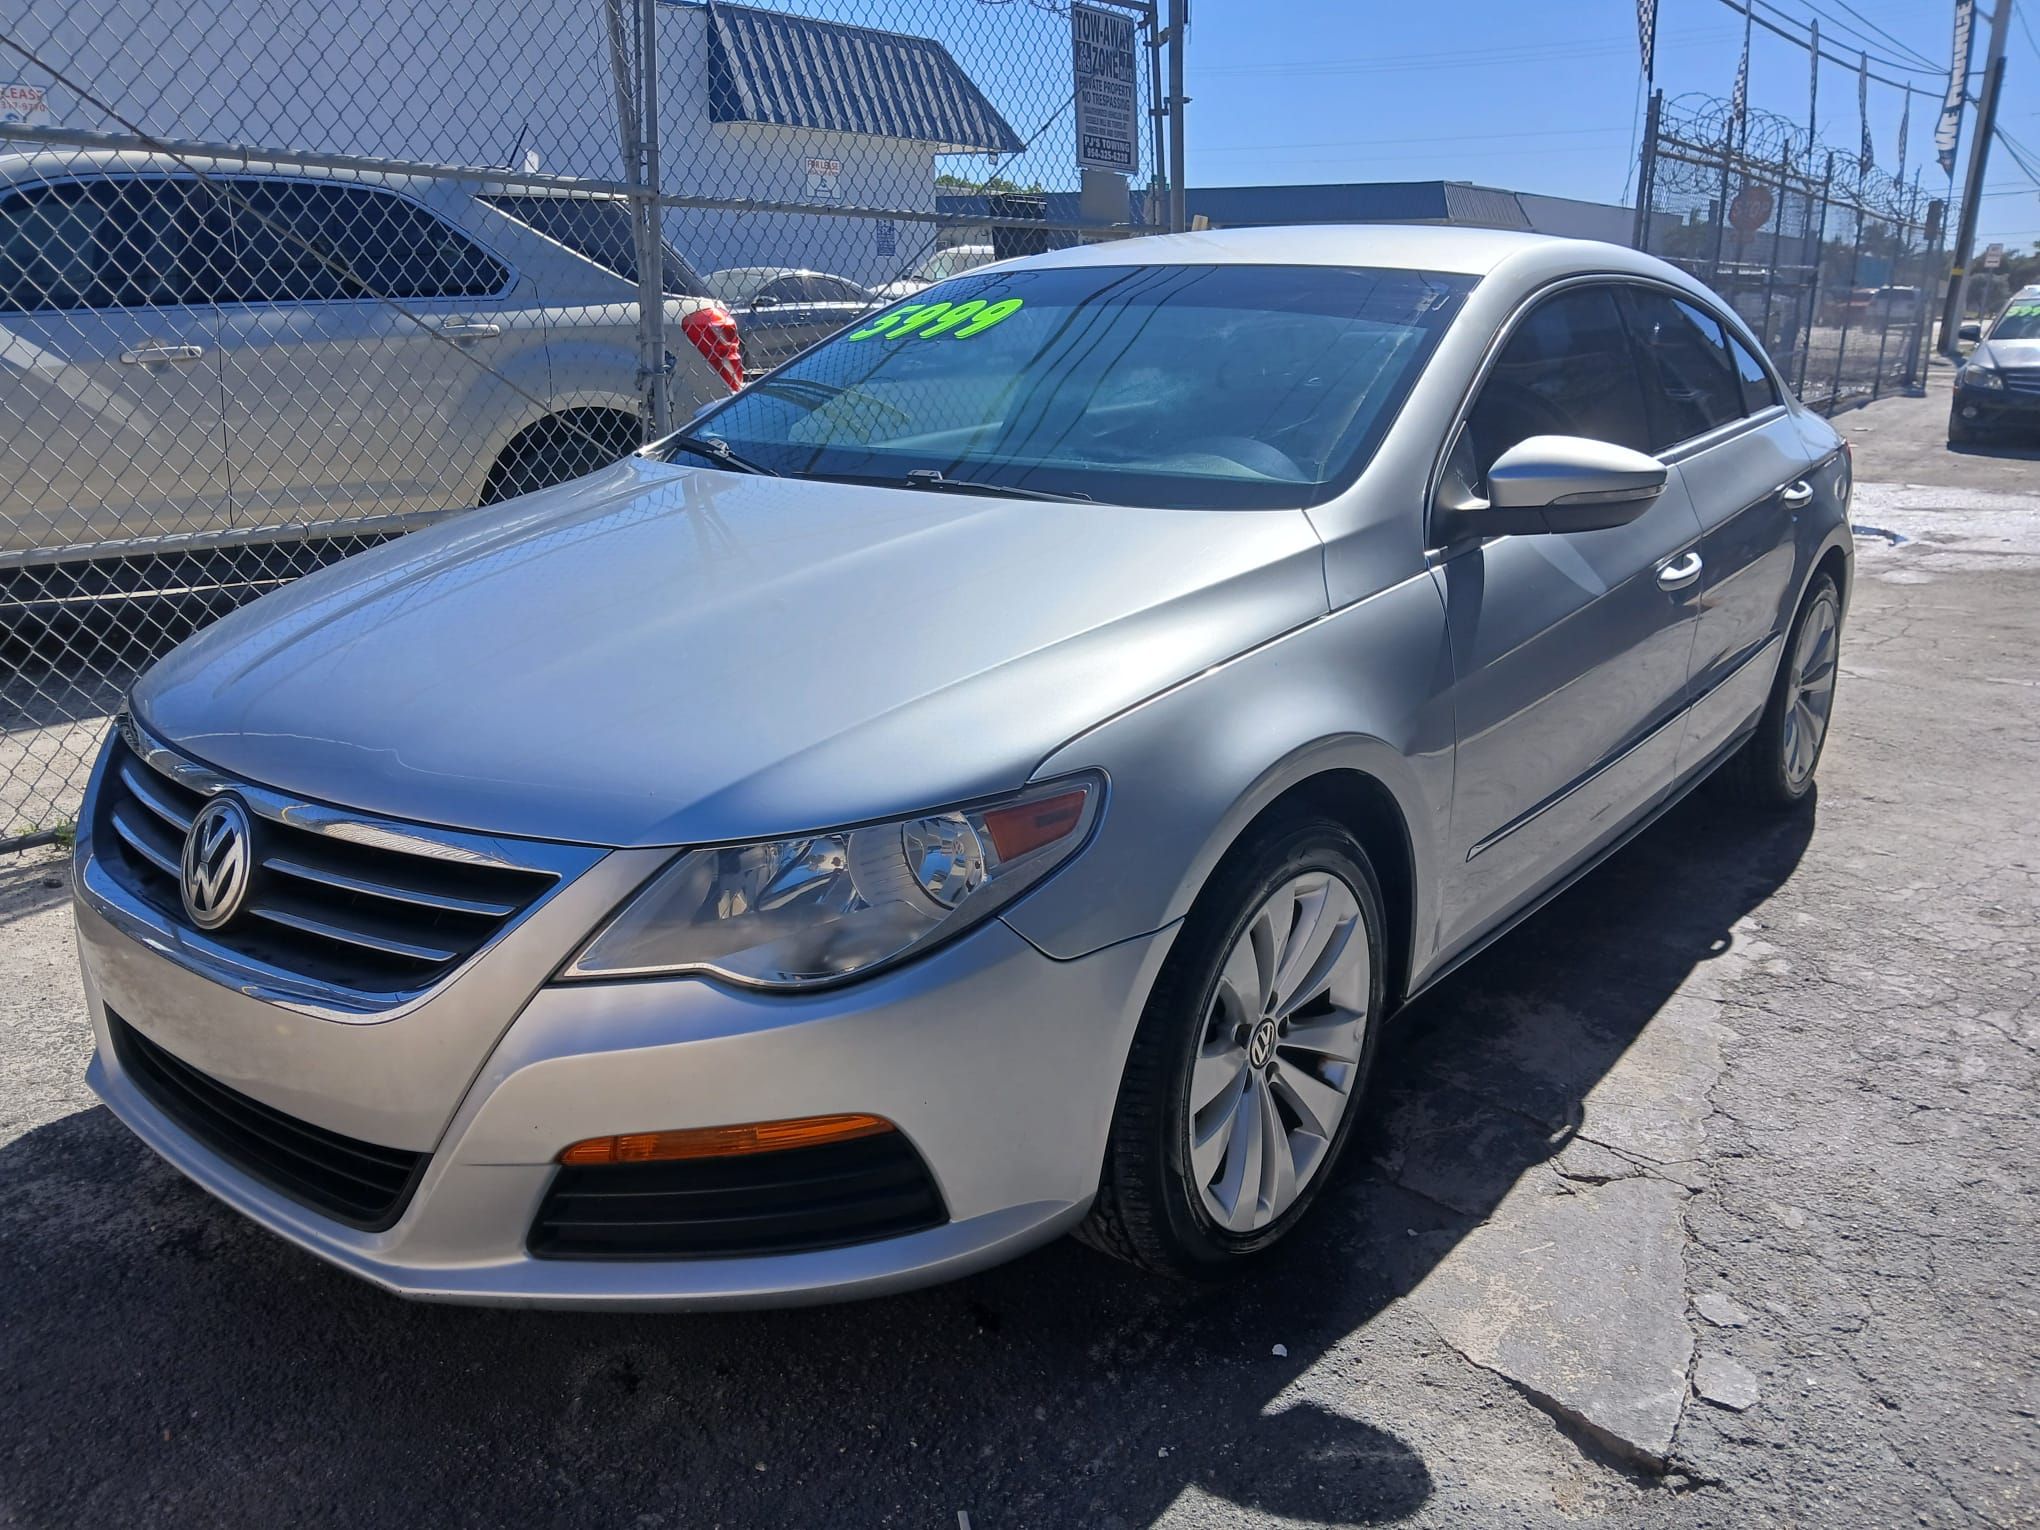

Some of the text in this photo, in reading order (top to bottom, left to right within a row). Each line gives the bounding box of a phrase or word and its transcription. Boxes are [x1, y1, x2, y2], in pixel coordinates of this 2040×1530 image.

[1075, 10, 1131, 51] TOW-AWAY
[1080, 42, 1090, 57] 24
[1077, 56, 1091, 73] HRS
[1092, 46, 1119, 79] ZONE
[1079, 76, 1131, 98] PRIVATE PROPERTY
[1082, 90, 1130, 111] NO TRESPASSING
[1935, 110, 1960, 151] WE
[1084, 136, 1130, 153] PJ'S TOWING
[849, 299, 1024, 341] 5999
